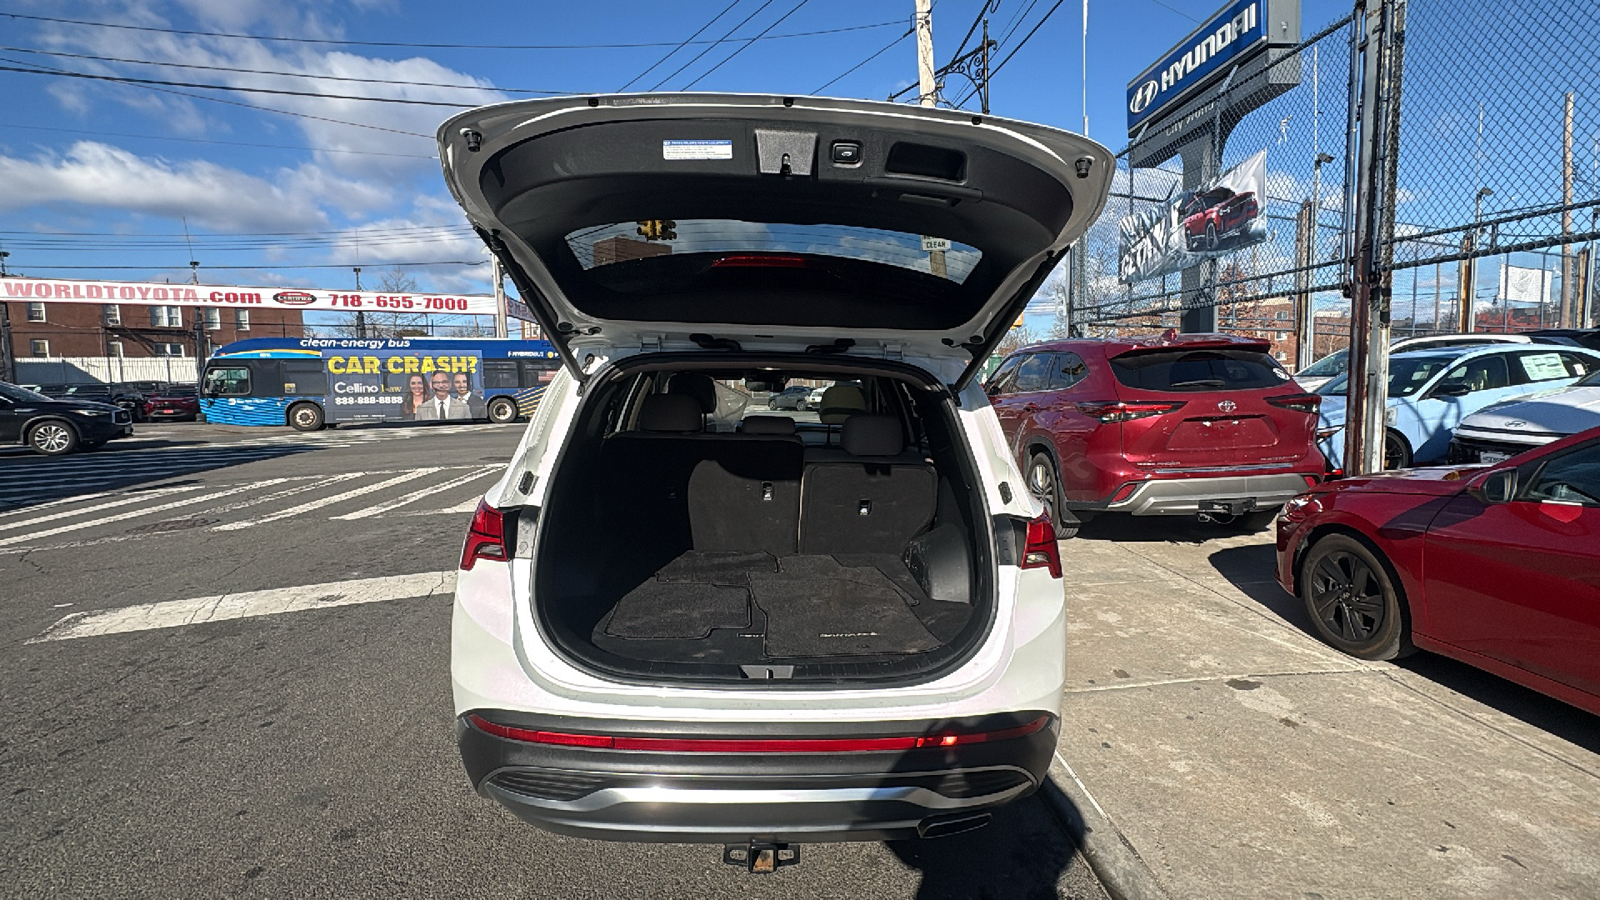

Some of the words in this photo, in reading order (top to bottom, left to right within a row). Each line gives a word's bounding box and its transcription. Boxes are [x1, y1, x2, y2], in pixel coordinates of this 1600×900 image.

[1161, 2, 1256, 92] HYUNDAI
[4, 282, 262, 303] WORLDTOYOTA.com
[299, 337, 385, 349] clean-energy
[388, 338, 411, 348] bus
[328, 356, 380, 374] CAR
[387, 356, 478, 374] CRASH?
[334, 381, 379, 394] Cellino
[334, 396, 404, 405] 888-888-8888
